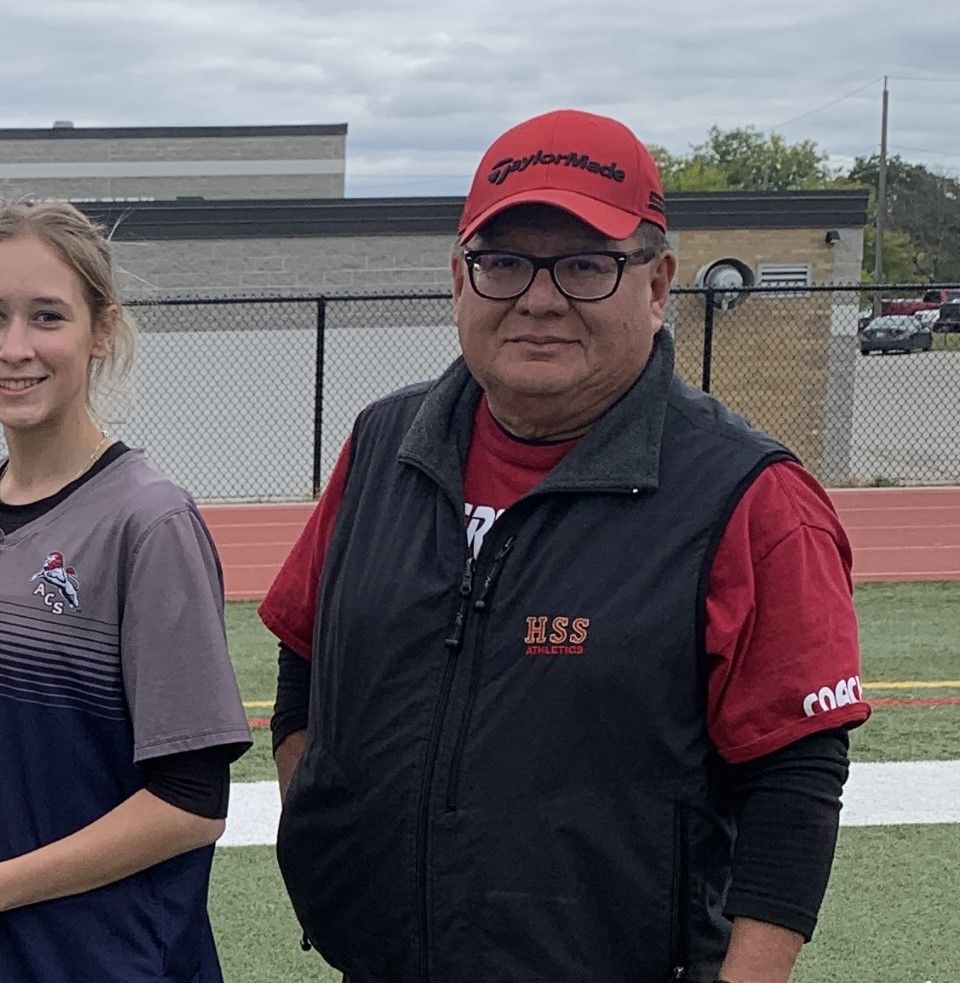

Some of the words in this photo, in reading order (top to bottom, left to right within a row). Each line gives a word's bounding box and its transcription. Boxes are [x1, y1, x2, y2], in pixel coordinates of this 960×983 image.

[488, 150, 626, 185] TaylorMade
[34, 583, 64, 615] ACS
[524, 616, 590, 644] HSS
[526, 645, 584, 655] ATHLETICS
